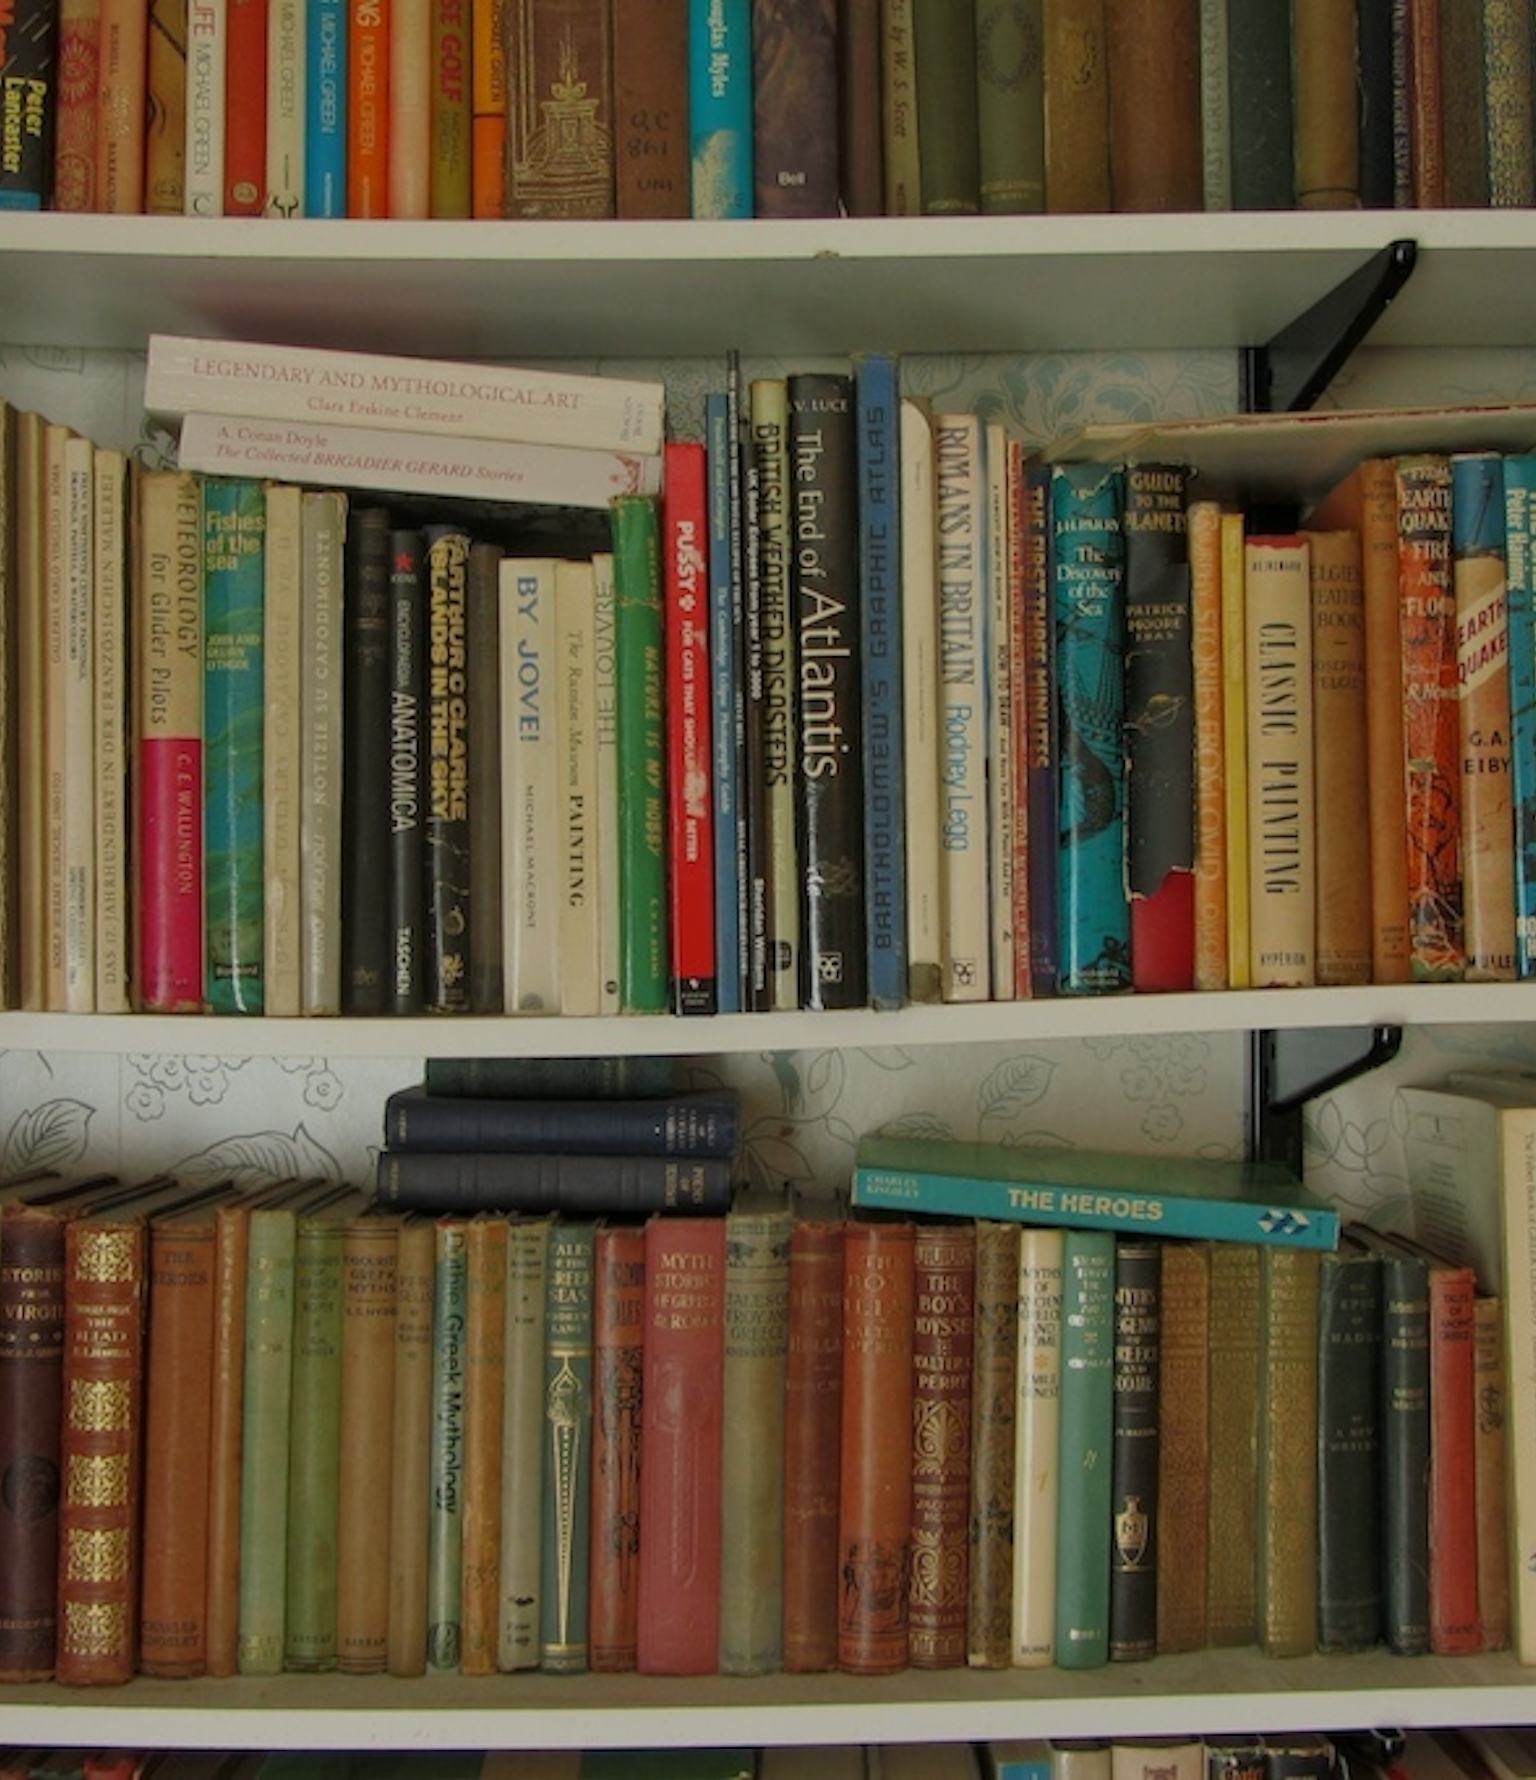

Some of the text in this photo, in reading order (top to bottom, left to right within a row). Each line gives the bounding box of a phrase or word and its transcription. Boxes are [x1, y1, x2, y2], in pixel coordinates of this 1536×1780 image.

[320, 12, 337, 135] MICHAEL GREEN
[440, 33, 465, 104] GOLF
[706, 0, 731, 99] ouglas Myles
[3, 77, 25, 173] Lancaster
[25, 81, 47, 138] Peter
[193, 43, 212, 176] MICHAEL GREEN
[360, 36, 376, 155] MICHAEL GREEN
[777, 171, 807, 187] Bell
[191, 358, 584, 411] LEGENDARY AND MYTHOLOGICAL ART
[306, 395, 465, 424] Clara Erskine Clement
[215, 445, 525, 485] The Collected BRIGADIER GERARD Stories
[237, 429, 282, 444] Conan
[286, 430, 329, 449] Doyle
[796, 429, 825, 481] The
[100, 473, 115, 553] MALEREI
[798, 489, 826, 540] End
[1129, 472, 1183, 491] GUIDE
[1506, 487, 1528, 529] Peter
[207, 511, 264, 532] Fishes
[207, 534, 261, 554] of the
[676, 520, 696, 593] PUSSY
[177, 482, 199, 659] METEOROLOGY
[206, 556, 238, 570] sea
[798, 547, 827, 578] of
[150, 553, 172, 725] for Glider Pilots
[681, 619, 694, 647] FOR
[758, 423, 788, 787] BRITISH WEATHER DISASTERS
[937, 426, 976, 852] ROMANS IN BRITAIN Rodney Legg
[1126, 603, 1187, 617] PATRICK
[1127, 618, 1181, 632] MOORE
[1457, 598, 1506, 647] EARTH
[99, 560, 116, 731] FRANZÖSISCHEN
[312, 527, 331, 806] NOTIZIE SU CAPODIMONTE
[517, 575, 541, 742] BY JOVE!
[568, 631, 584, 658] The
[596, 581, 616, 753] THE LOUVRE
[682, 649, 695, 680] CATS
[866, 406, 892, 949] BARTHOLOMEW'S GRAPHIC ATLAS
[1457, 632, 1507, 684] QUAKE
[448, 541, 466, 820] ARTHUR C CLARKE
[682, 682, 696, 715] THAT
[800, 586, 852, 779] Atlantis
[429, 667, 449, 821] IN THE SKY
[1028, 668, 1050, 769] MINUTES
[101, 761, 117, 782] IN
[390, 690, 418, 834] ANATOMICA
[1259, 623, 1300, 894] CLASSIC PAINTING
[1464, 759, 1512, 775] EIBY
[102, 790, 118, 920] JAHRHUNDERT
[177, 790, 193, 895] WALLINGTON
[524, 784, 539, 929] MICHAEL MACRONE
[568, 794, 585, 908] PAINTING
[102, 952, 119, 986] DAS
[395, 925, 412, 996] TASCHEN
[1008, 1187, 1165, 1220] THE HEROES
[2, 1266, 62, 1282] STORIE
[927, 1275, 962, 1293] THE
[447, 1313, 465, 1385] Greek
[919, 1374, 971, 1391] PERRY
[437, 1391, 463, 1515] Mythology
